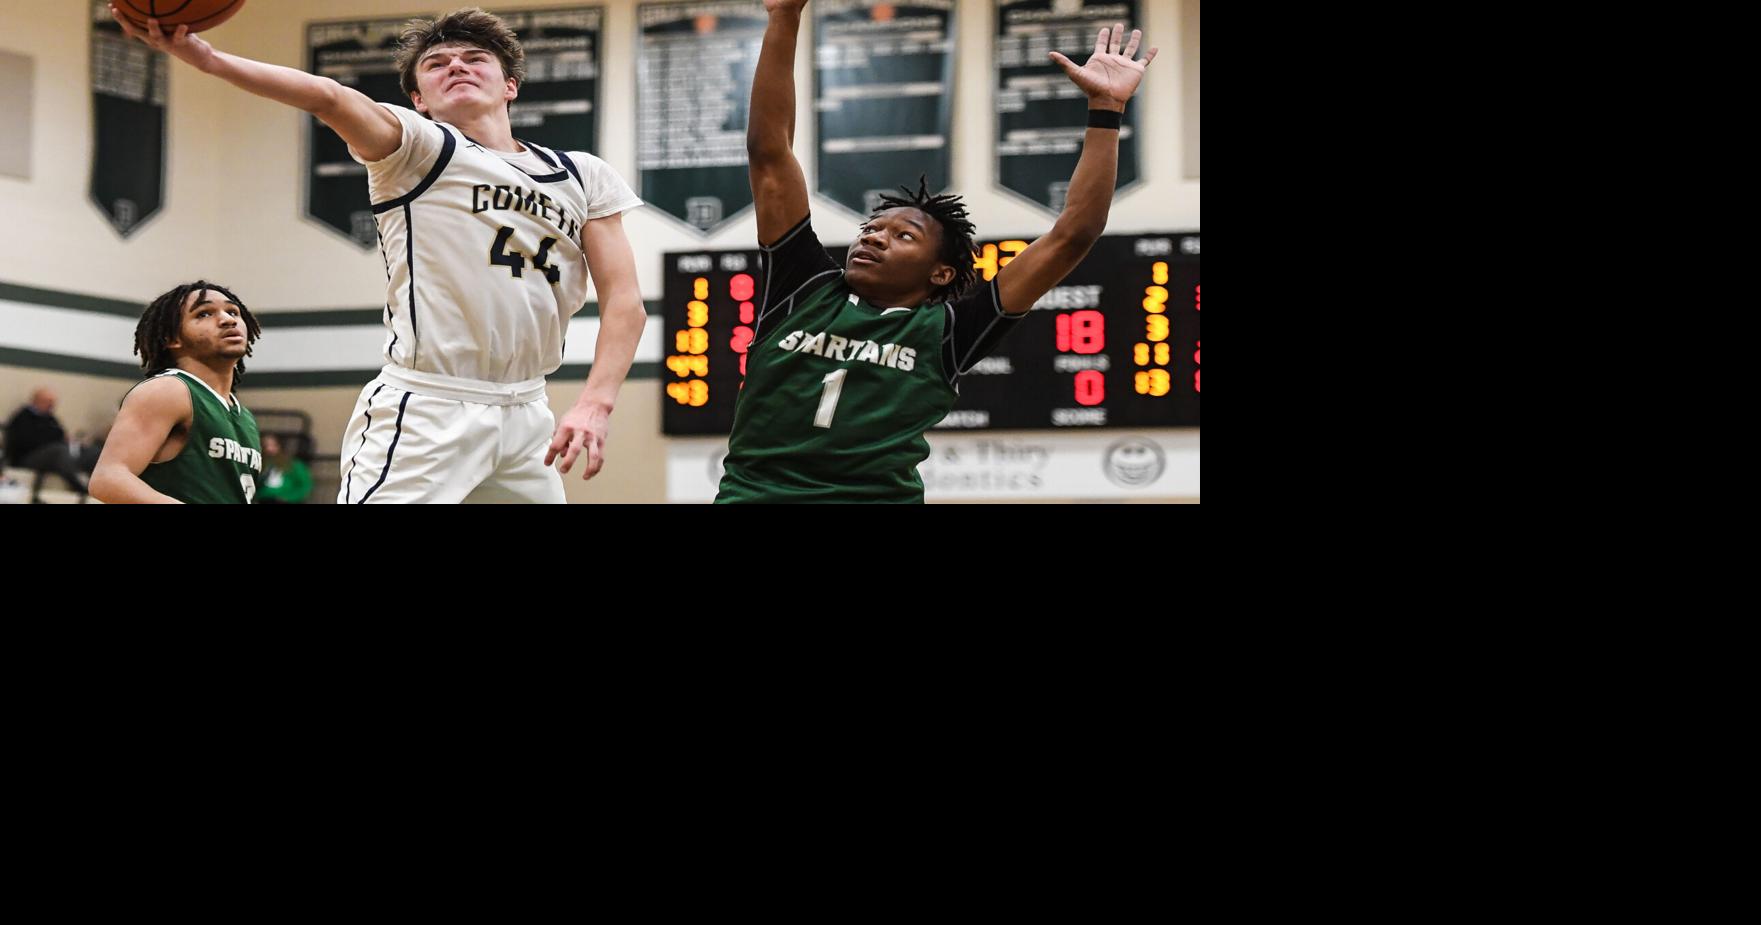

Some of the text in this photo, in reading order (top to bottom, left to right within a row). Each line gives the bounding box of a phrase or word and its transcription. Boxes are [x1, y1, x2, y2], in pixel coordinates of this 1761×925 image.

[472, 184, 579, 239] COMET
[490, 226, 560, 284] 44
[687, 300, 709, 327] 3
[1031, 285, 1102, 309] UEST
[1142, 285, 1169, 314] 2
[1056, 310, 1105, 354] 18
[1145, 313, 1170, 342] 3
[778, 330, 917, 371] SPARTANS
[813, 368, 848, 429] 1
[1074, 370, 1105, 406] 0
